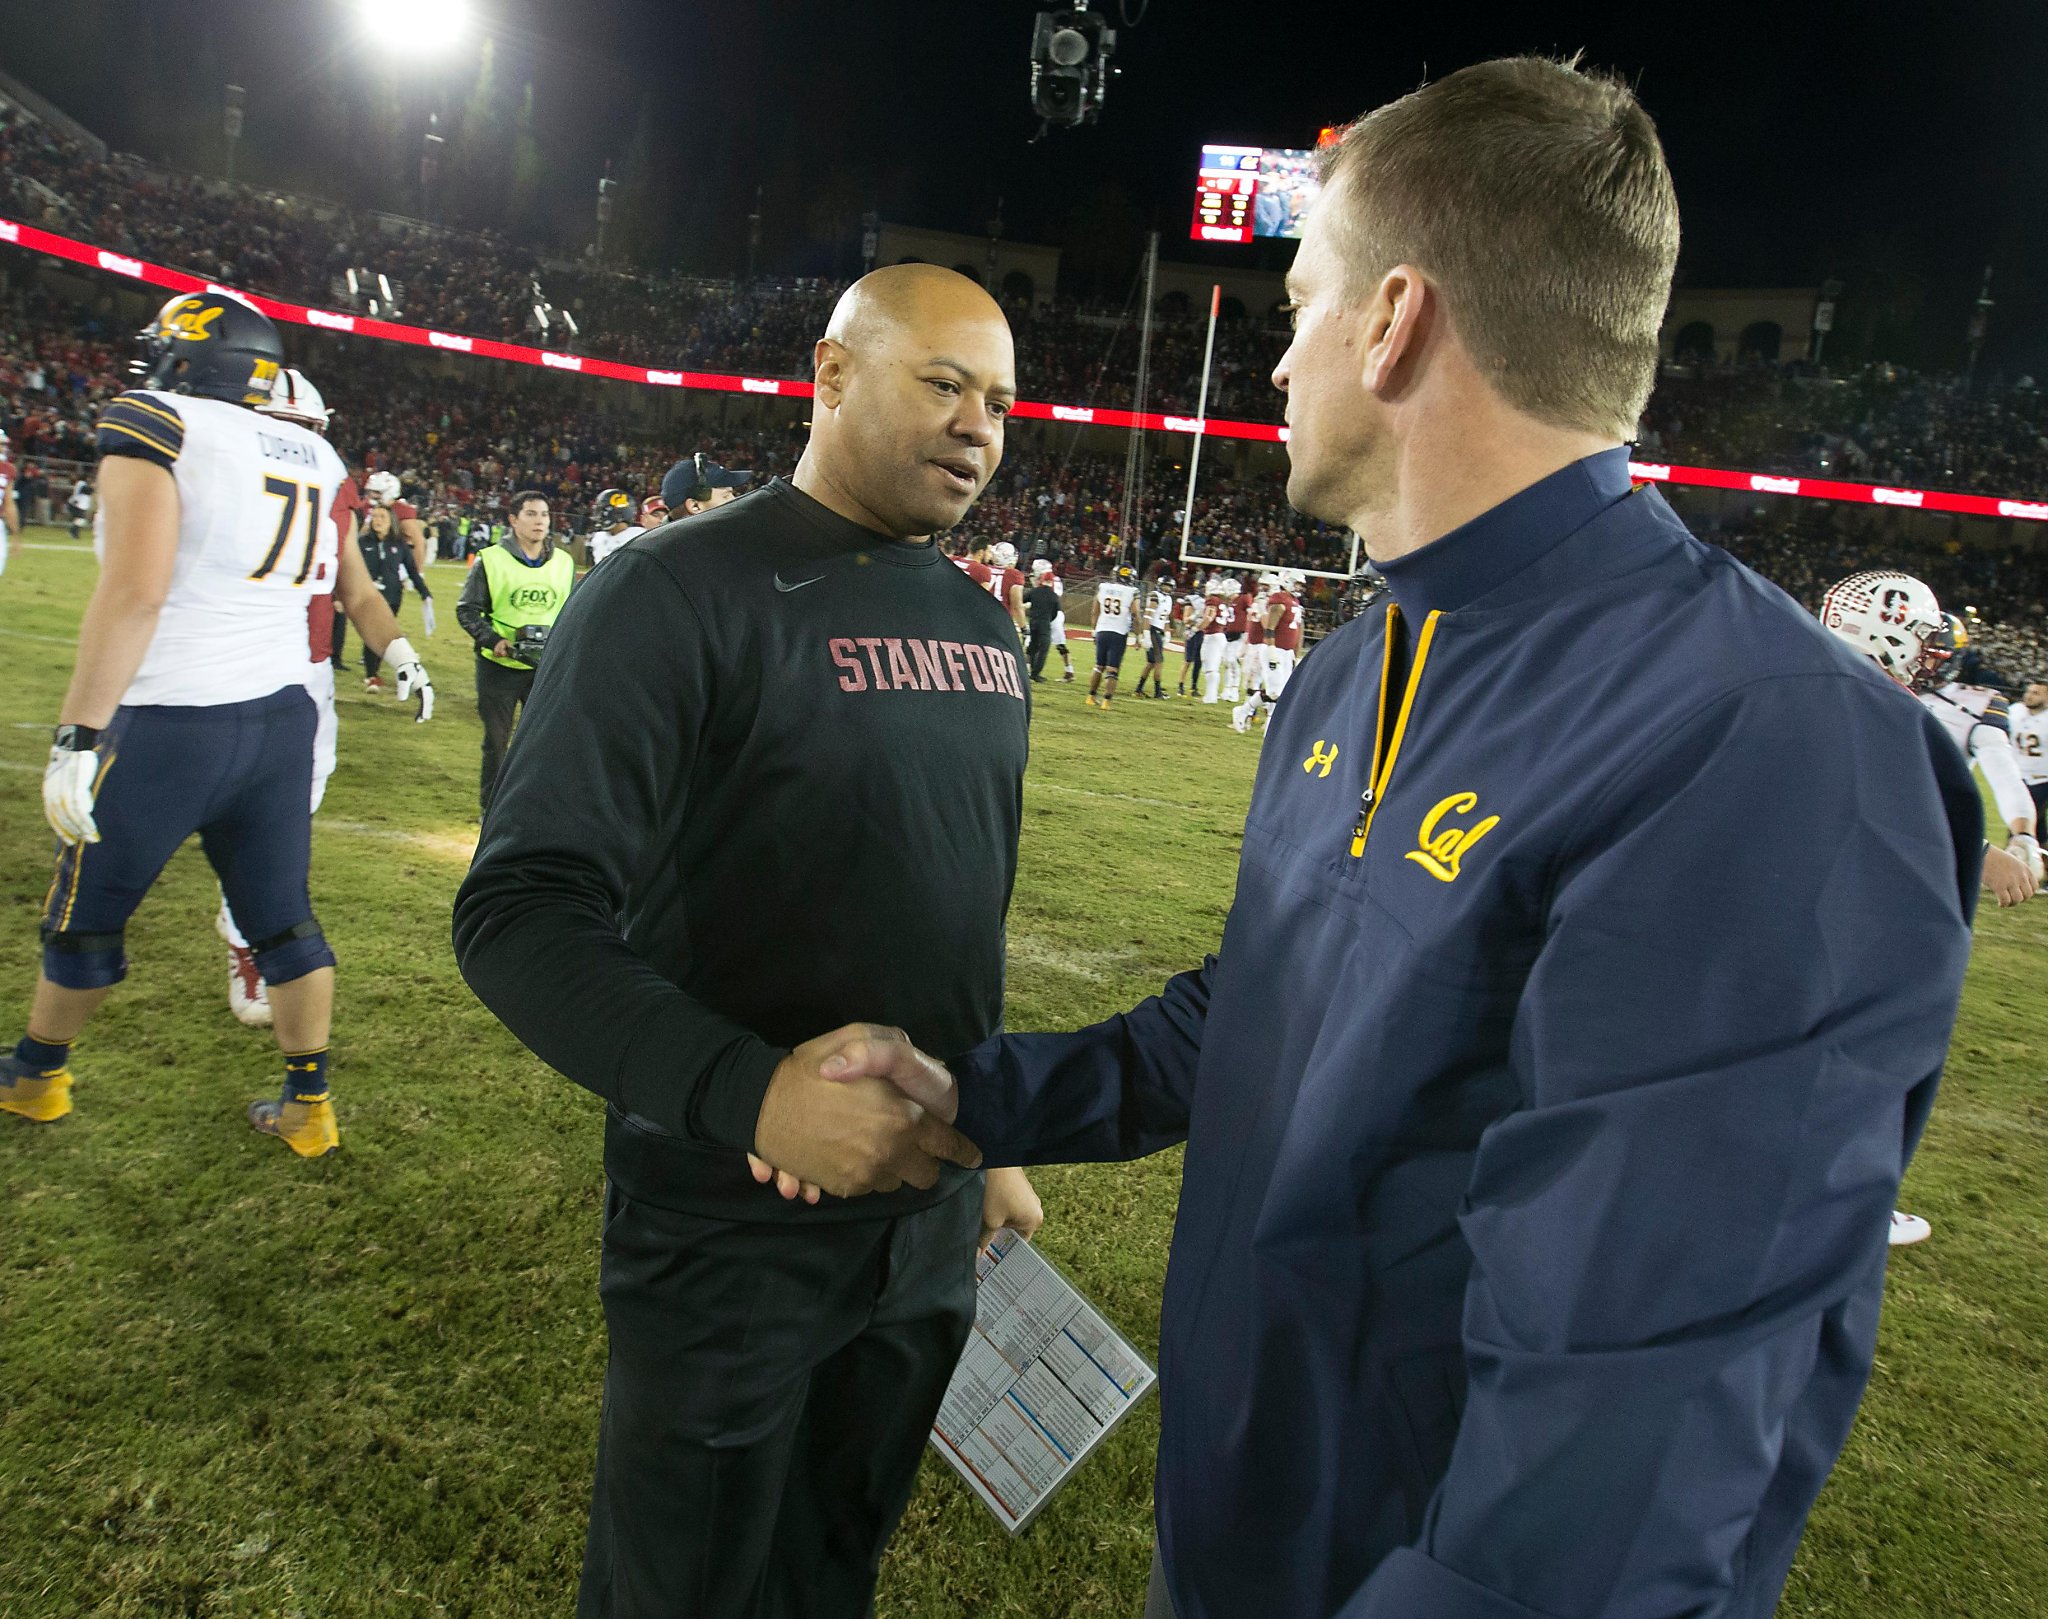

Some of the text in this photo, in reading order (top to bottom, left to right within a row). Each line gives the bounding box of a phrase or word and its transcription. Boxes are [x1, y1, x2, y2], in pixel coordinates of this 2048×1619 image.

[160, 300, 225, 341] Cal
[246, 472, 320, 587] 71
[520, 590, 549, 602] FOX
[1404, 791, 1501, 883] Cal
